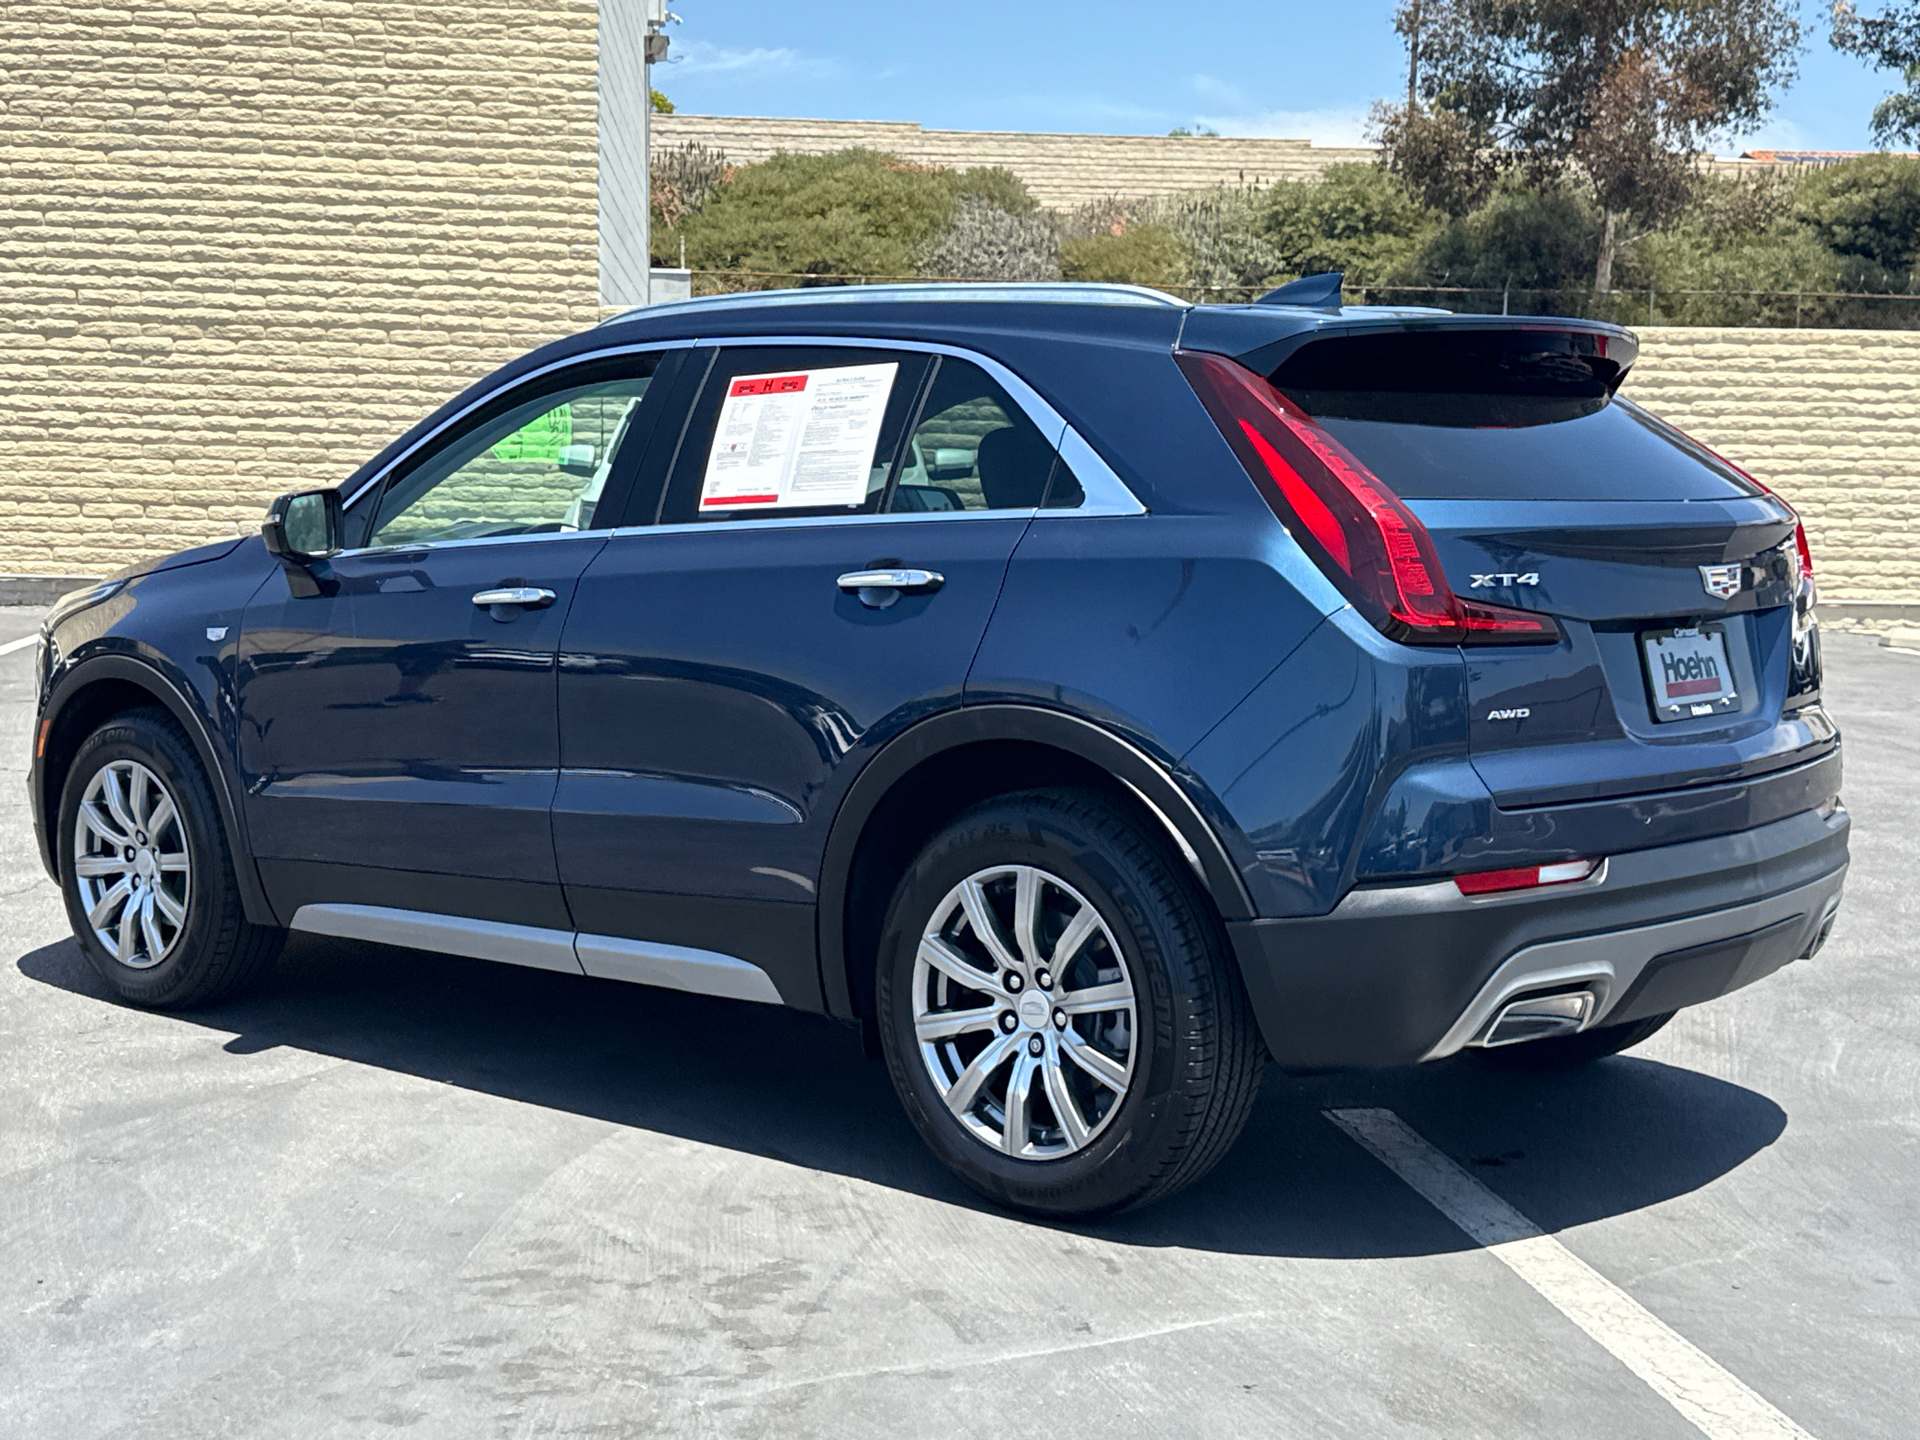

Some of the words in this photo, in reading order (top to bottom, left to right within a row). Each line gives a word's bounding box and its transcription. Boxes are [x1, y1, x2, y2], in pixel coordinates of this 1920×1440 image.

[1470, 573, 1540, 588] XT4
[1660, 650, 1719, 682] Hoehn
[1487, 708, 1531, 721] AWD
